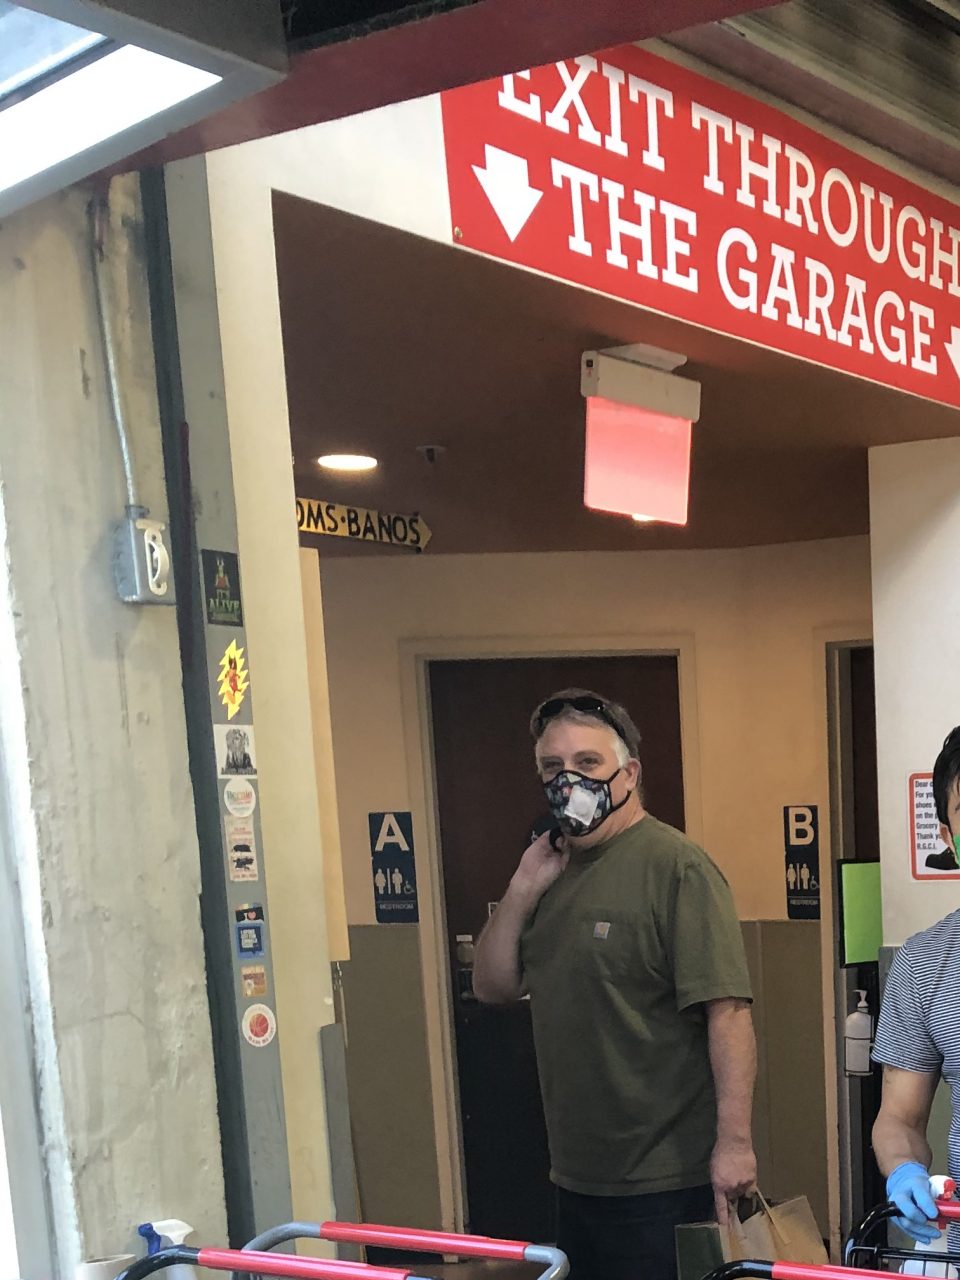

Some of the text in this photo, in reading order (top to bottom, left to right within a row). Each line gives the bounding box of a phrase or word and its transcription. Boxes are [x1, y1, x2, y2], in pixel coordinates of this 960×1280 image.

[551, 157, 938, 376] THE GARAGE
[915, 780, 928, 788] Dear
[375, 813, 410, 851] A
[788, 807, 814, 845] B
[916, 822, 938, 831] Grocery
